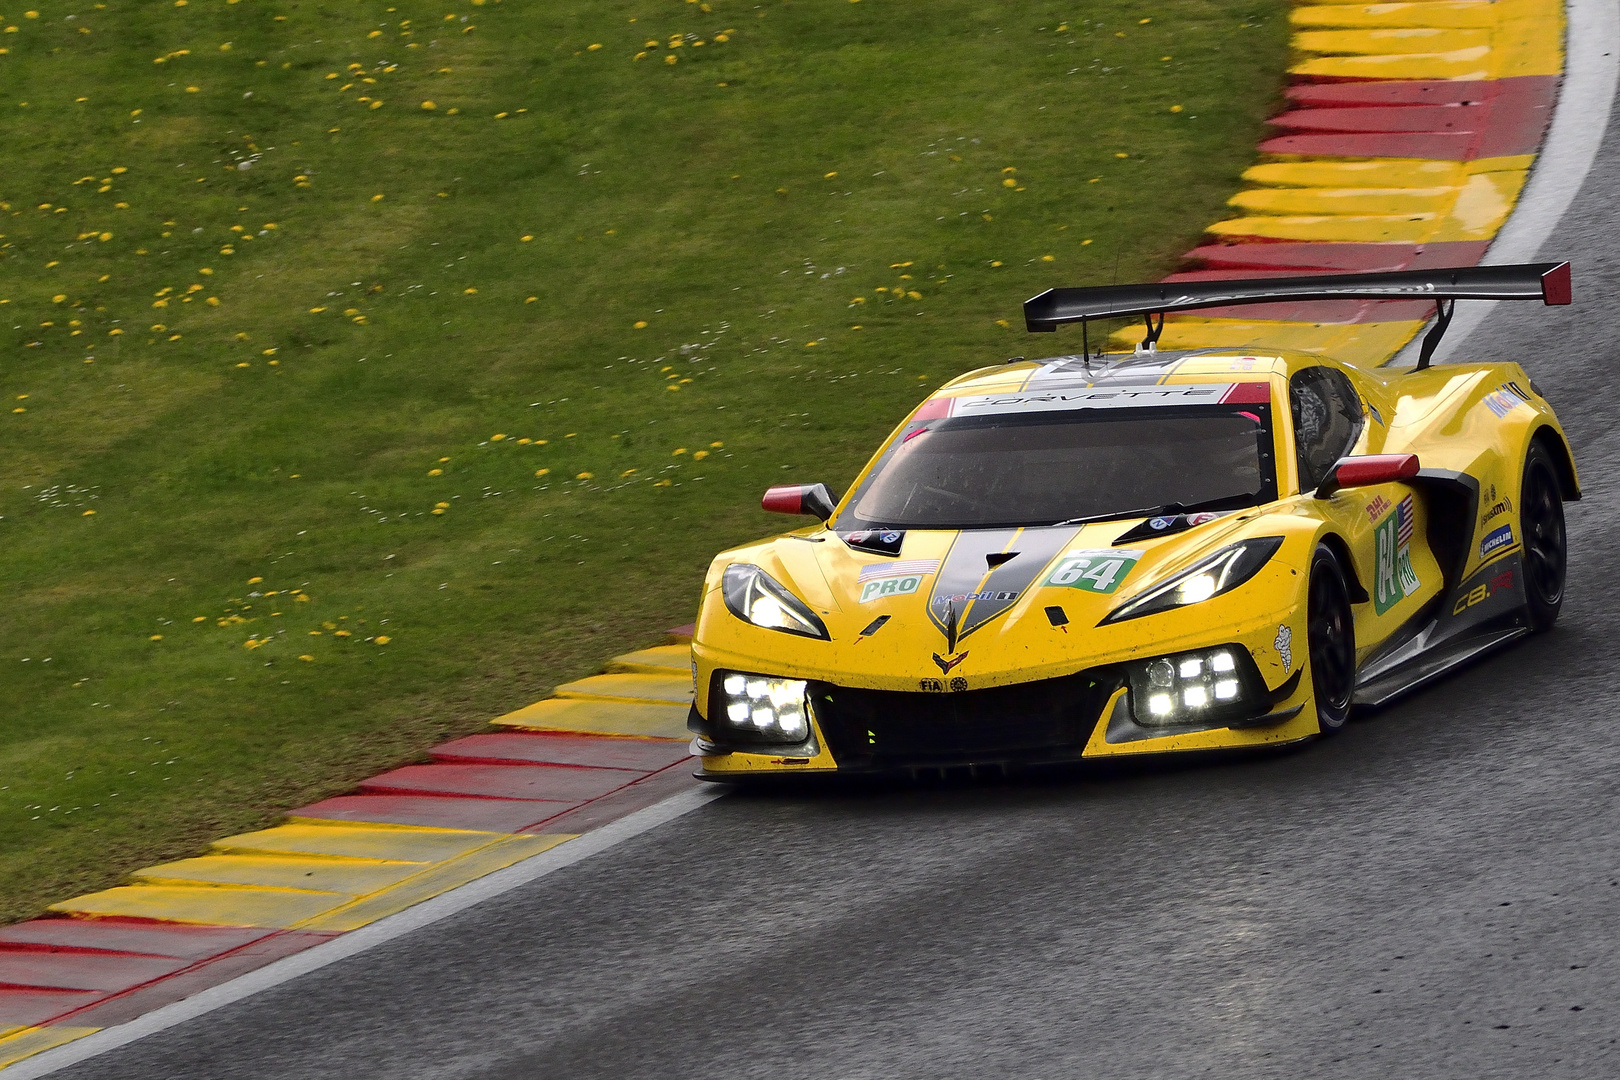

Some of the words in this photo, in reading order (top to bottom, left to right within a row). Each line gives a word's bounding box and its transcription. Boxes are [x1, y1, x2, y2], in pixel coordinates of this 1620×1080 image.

[962, 387, 1216, 407] CORVETTE
[1484, 531, 1512, 553] MICHELIN
[1378, 519, 1396, 604] 64
[1049, 559, 1125, 591] 64
[862, 578, 918, 600] PRO
[932, 591, 994, 605] Mobil
[921, 680, 940, 692] FIA
